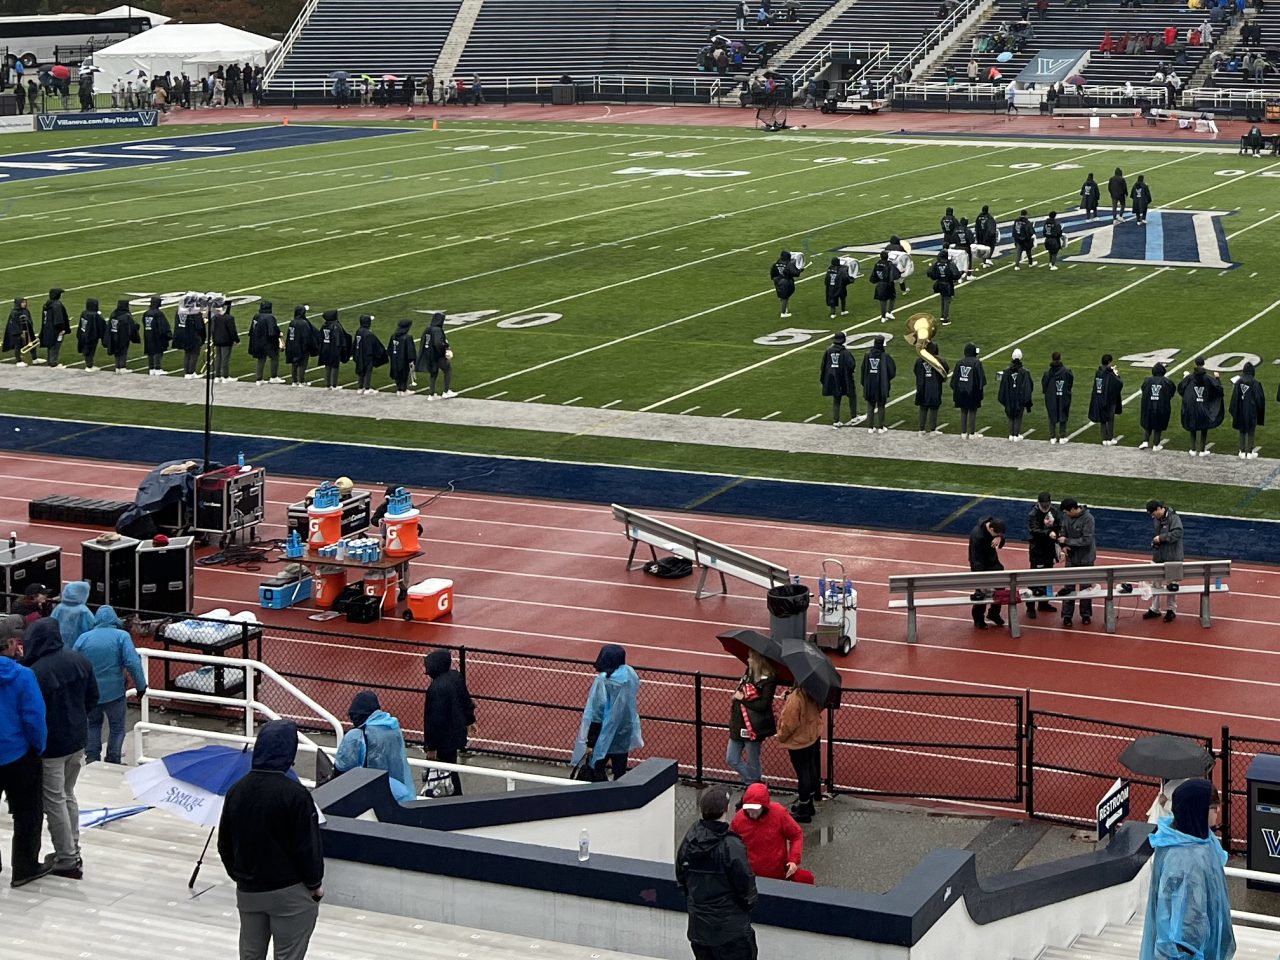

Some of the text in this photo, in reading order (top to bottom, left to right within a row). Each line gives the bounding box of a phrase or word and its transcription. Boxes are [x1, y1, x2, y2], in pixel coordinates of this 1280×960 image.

[57, 116, 138, 126] Villanova.com/BuyTickets
[437, 593, 449, 610] G
[160, 795, 194, 813] ADAMS
[166, 786, 205, 807] SAMUEL
[1100, 786, 1129, 822] RESTROOM
